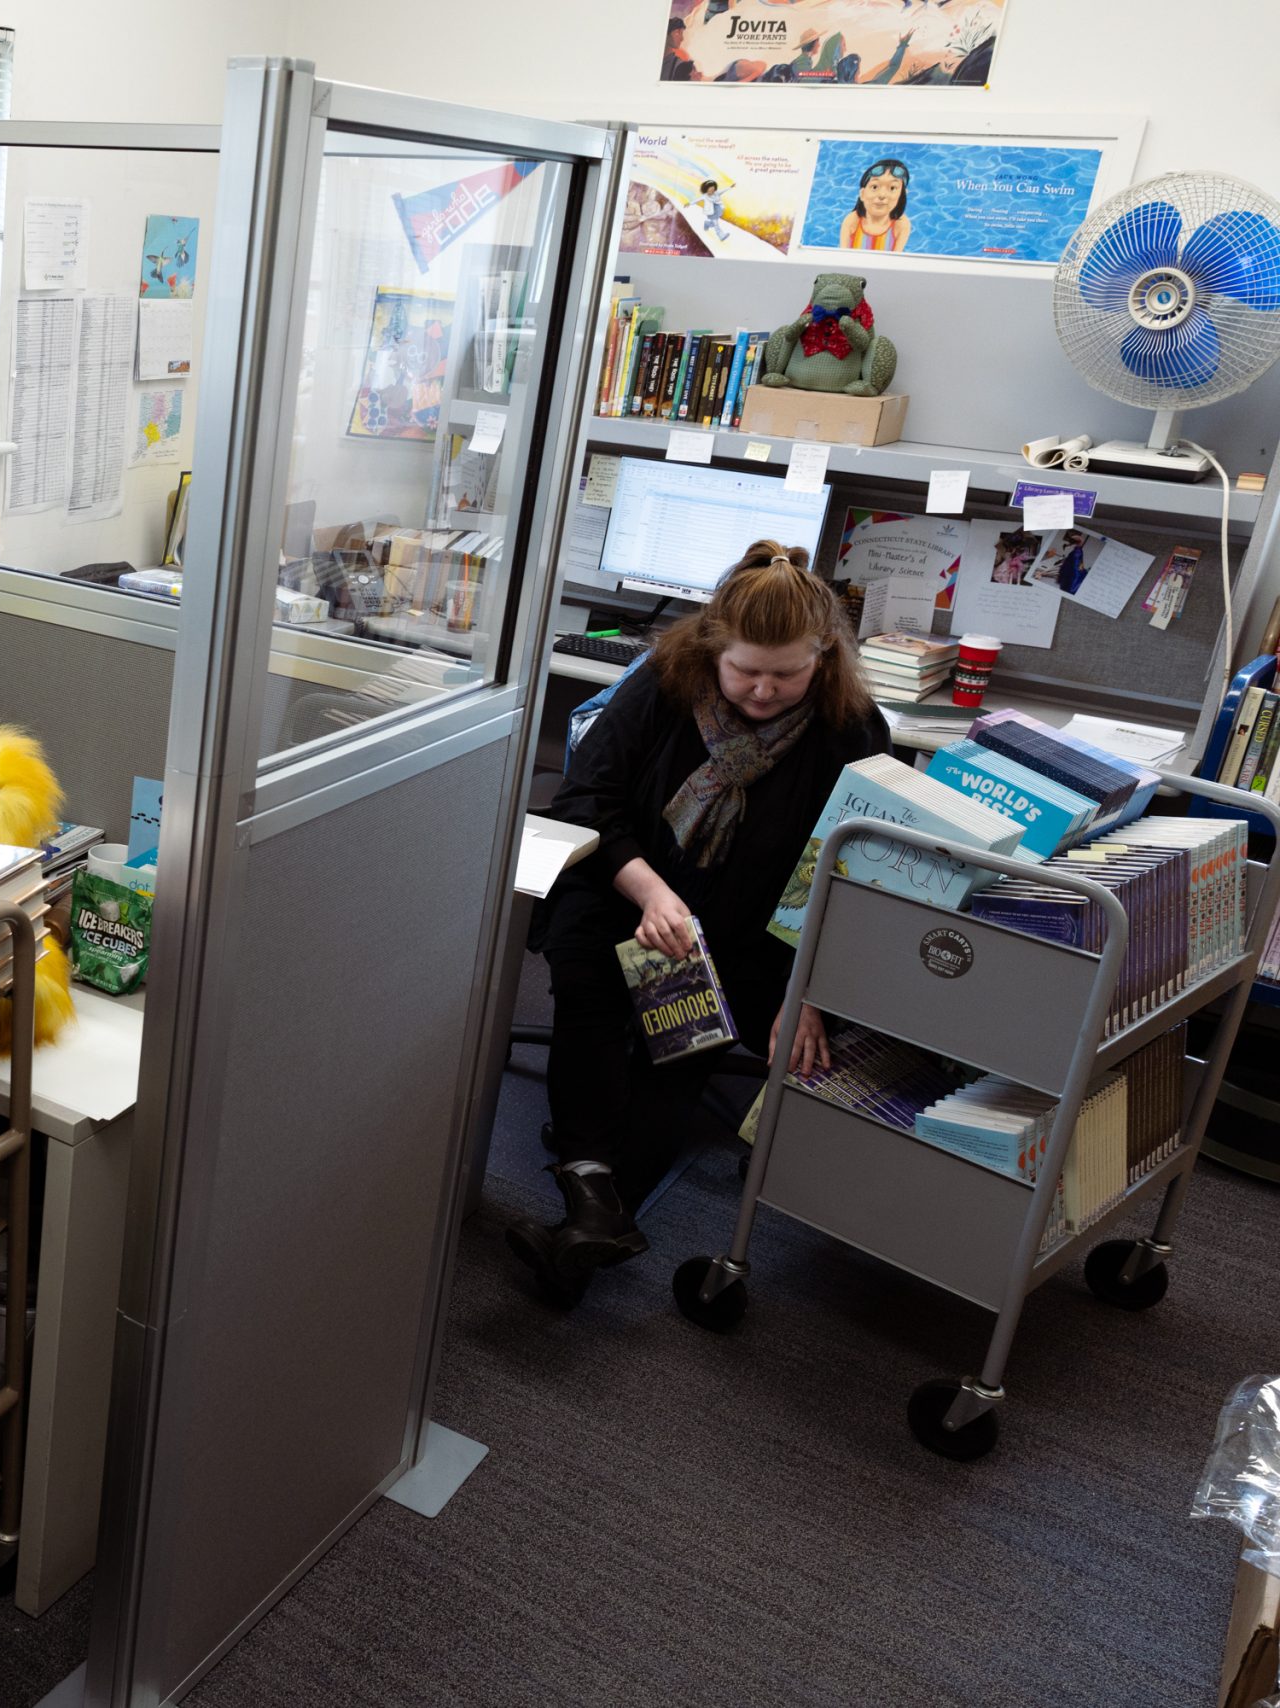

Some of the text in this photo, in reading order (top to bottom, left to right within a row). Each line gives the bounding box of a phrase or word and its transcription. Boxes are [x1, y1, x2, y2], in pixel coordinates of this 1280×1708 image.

[726, 15, 787, 39] JOVITA
[638, 136, 668, 146] World
[956, 180, 1075, 196] When You Can Swim
[853, 536, 904, 547] CONNECTICUT
[905, 537, 927, 547] STATE
[927, 542, 955, 559] LIBRARY
[868, 562, 925, 577] Library Science
[918, 555, 928, 565] of
[1255, 709, 1273, 743] CURSED
[945, 765, 1043, 823] The WORLD'S
[901, 807, 920, 824] The
[128, 879, 151, 893] dot
[78, 909, 145, 950] ICE BREAKERS
[81, 930, 138, 958] ICE CUBES
[922, 930, 972, 954] SMART CARTS
[641, 989, 720, 1036] GROUNDED
